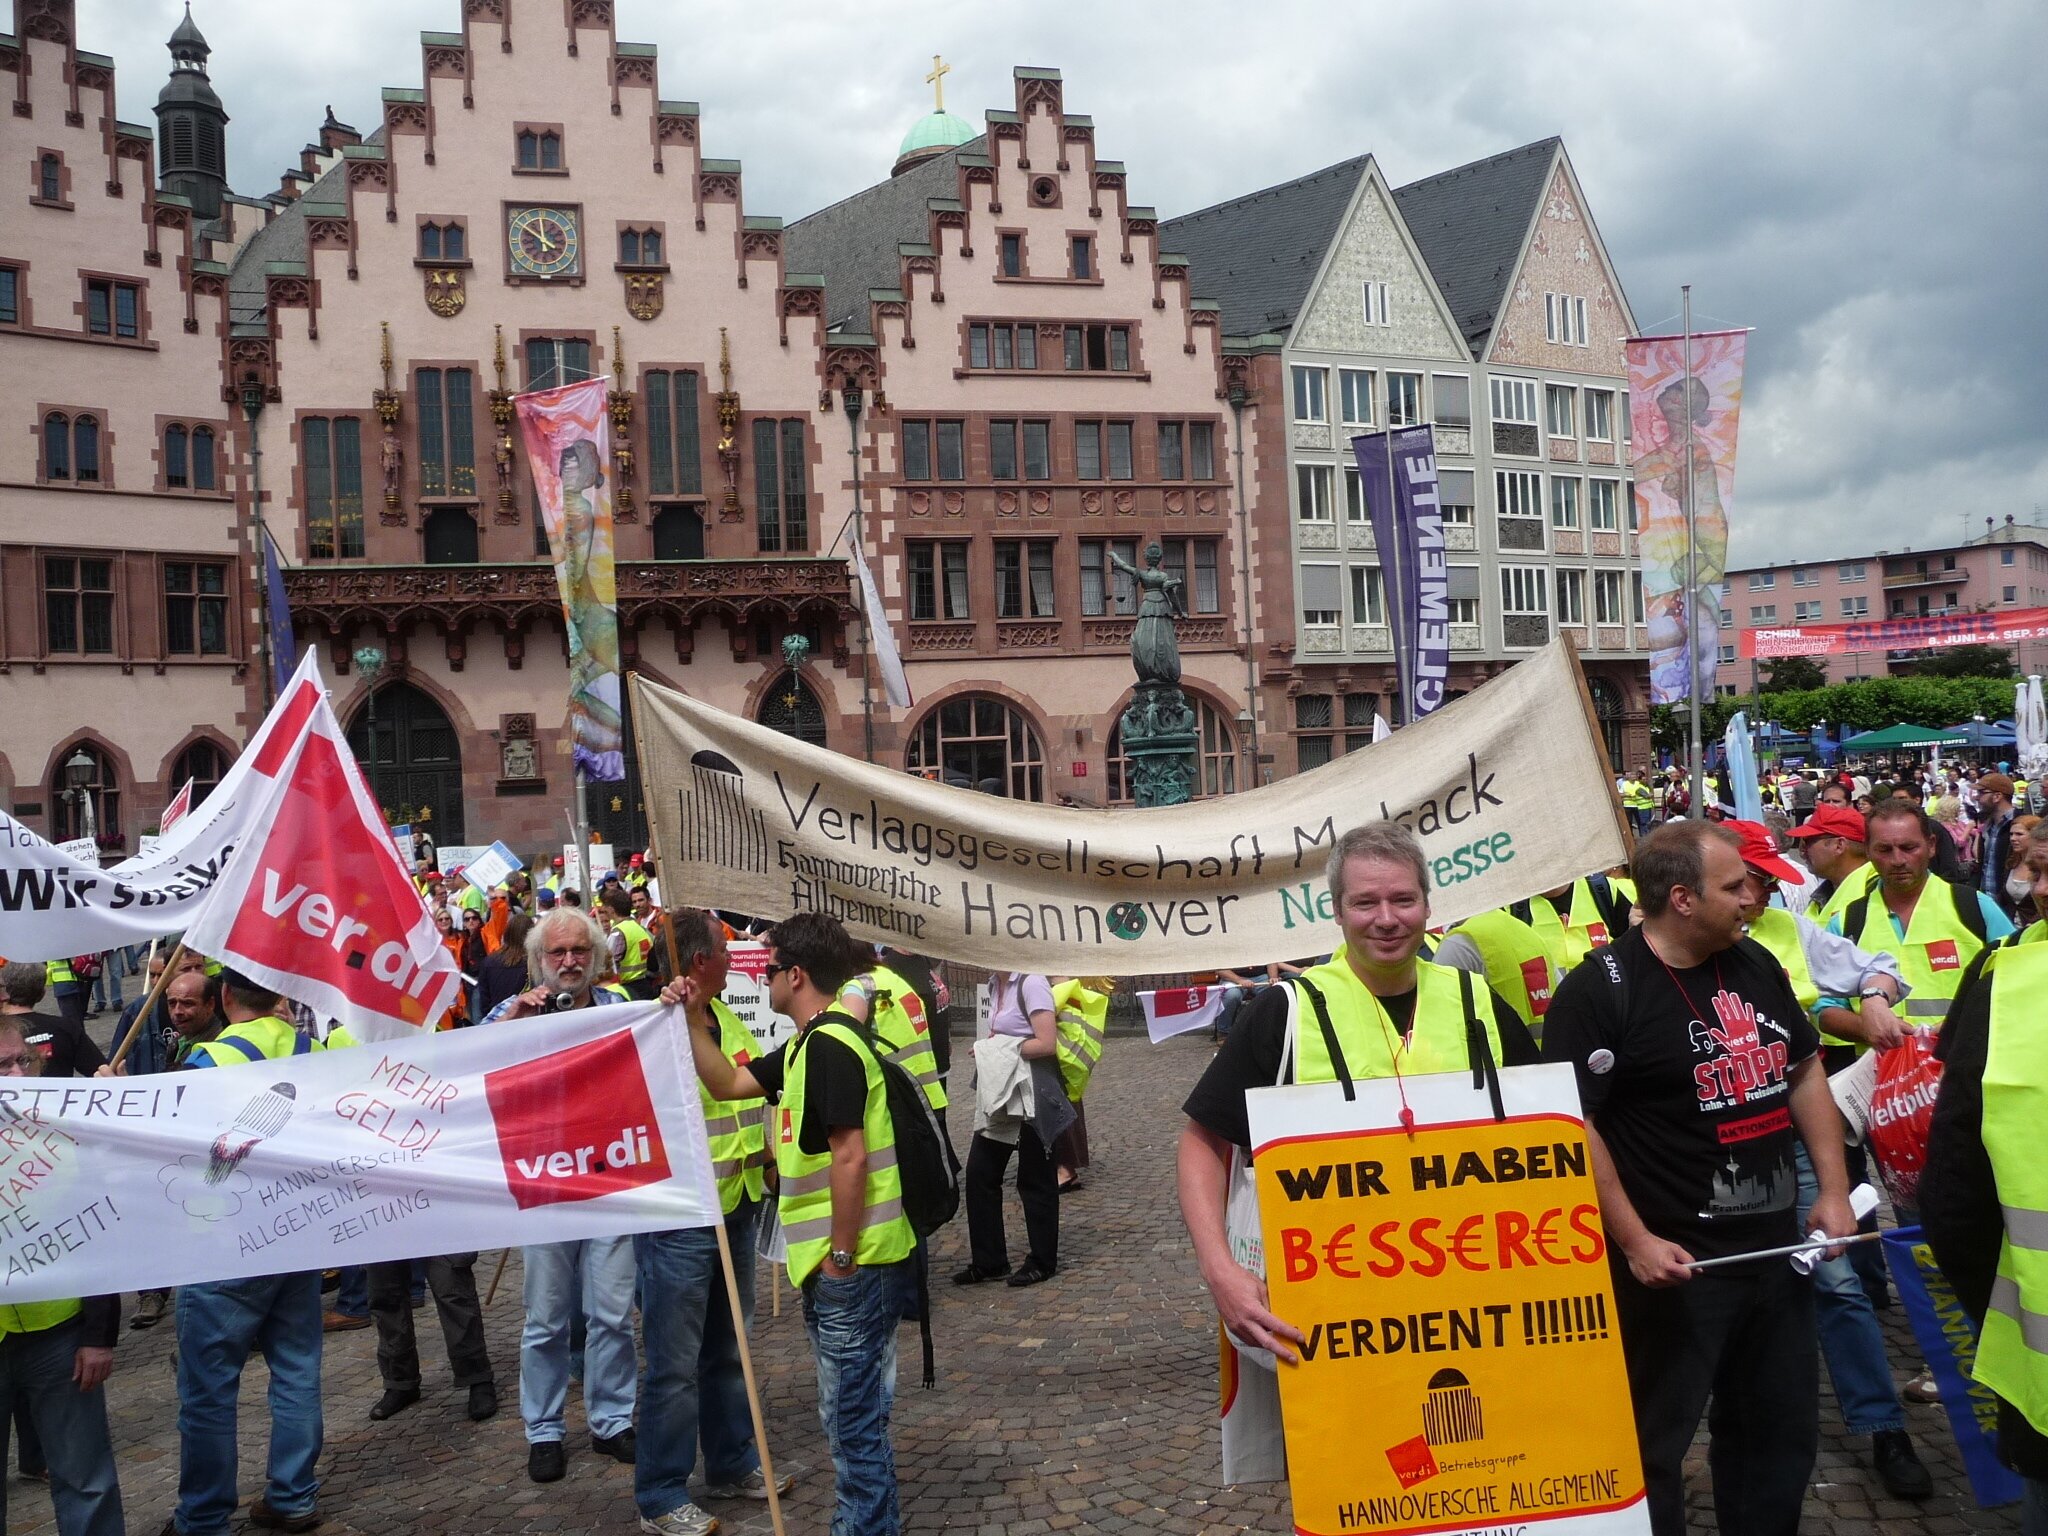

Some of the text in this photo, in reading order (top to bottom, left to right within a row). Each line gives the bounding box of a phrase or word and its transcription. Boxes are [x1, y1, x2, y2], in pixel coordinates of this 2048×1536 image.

[1755, 628, 1801, 640] SCHIRN
[1755, 634, 1837, 648] KUNSTHALLE
[1755, 643, 1830, 656] FRANKFURT
[1845, 614, 1997, 642] CLEMENTE
[1943, 634, 1977, 645] JUNI
[2003, 628, 2033, 639] SEP.
[773, 752, 1504, 880] Verlagsgesellschaft Msack
[0, 866, 98, 912] Wir
[790, 873, 927, 940] Allgemeine
[1930, 954, 1957, 965] ver.di
[727, 993, 761, 1005] Unsere
[370, 1055, 459, 1115] MEHR
[1693, 1040, 1788, 1102] STOPP
[334, 1092, 441, 1158] GELD!
[514, 1125, 651, 1180] ver.di
[259, 1146, 425, 1207] HANNOVERSCHE
[1275, 1141, 1587, 1202] WIR HABEN
[238, 1178, 373, 1258] ALLGEMEINE
[328, 1188, 431, 1245] ZEITUNG
[1714, 1199, 1766, 1213] Frankfurt
[5, 1195, 121, 1287] ARBEIT!
[1297, 1303, 1512, 1362] VERDIENT
[1439, 1452, 1527, 1475] Betriebsgruppe
[1338, 1468, 1623, 1529] HANNOVERSCHE ALLGEMEINE
